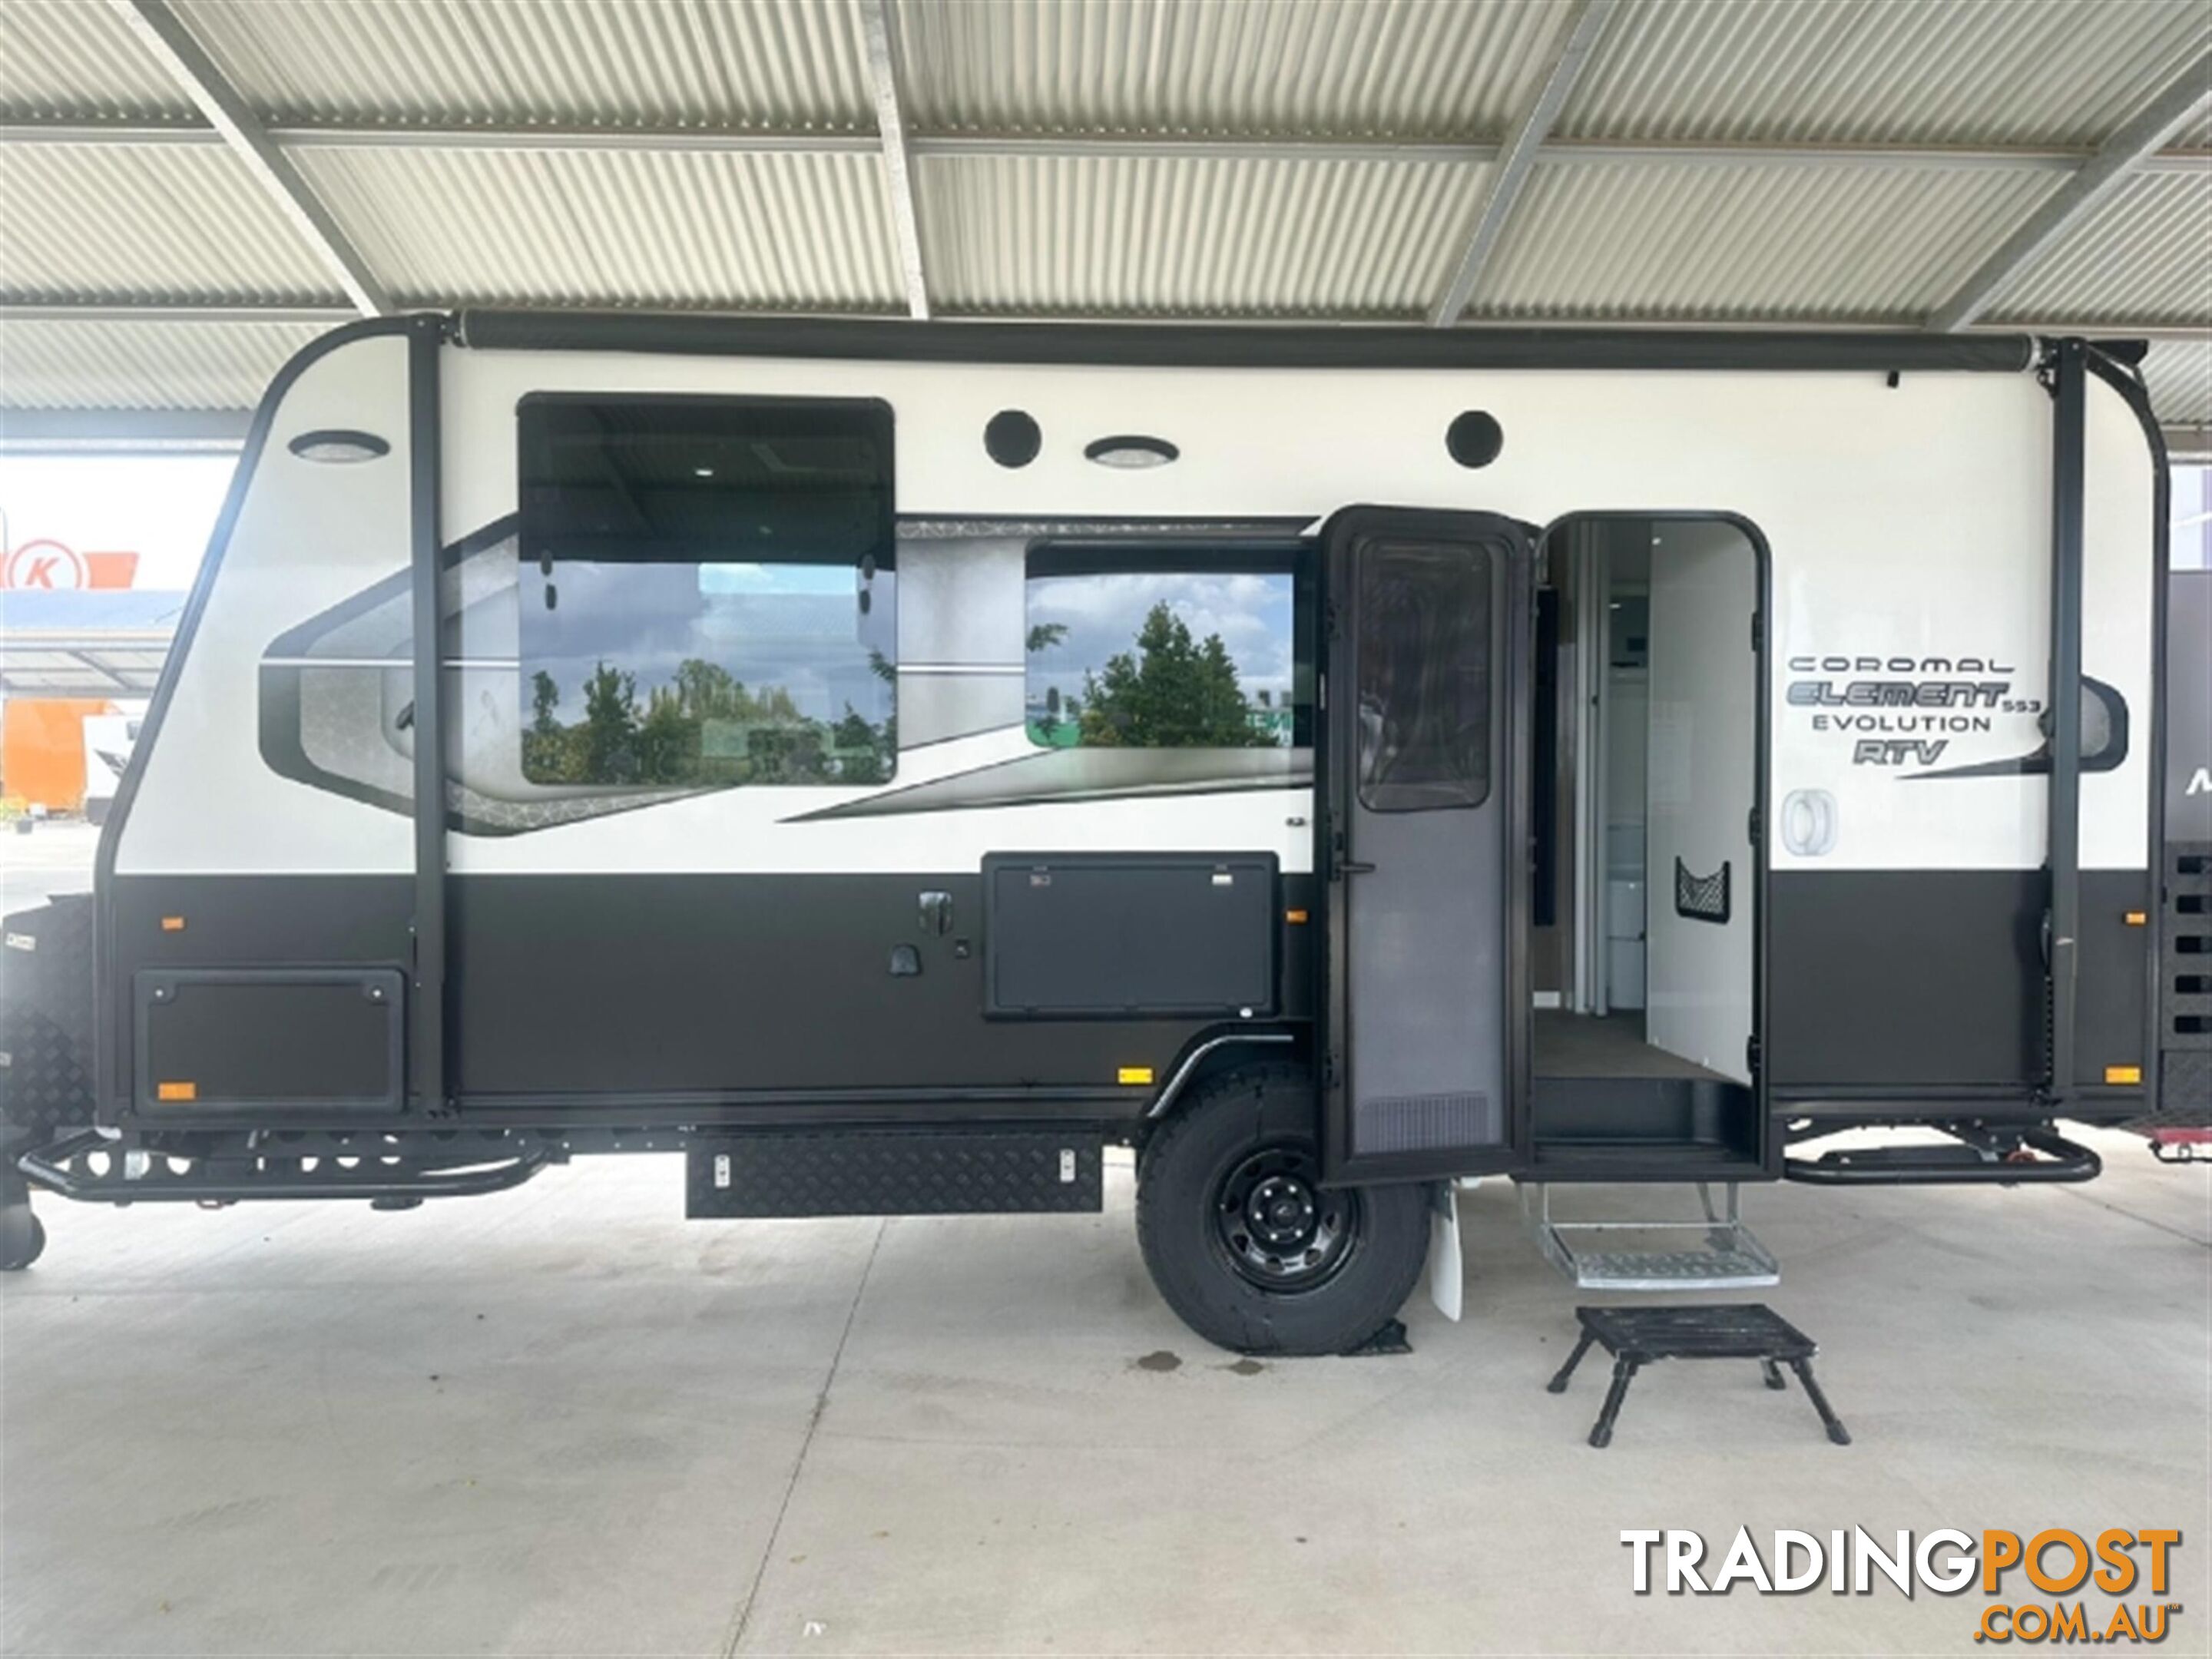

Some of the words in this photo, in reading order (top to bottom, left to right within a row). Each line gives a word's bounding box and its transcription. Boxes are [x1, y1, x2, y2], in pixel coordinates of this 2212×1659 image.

[25, 557, 60, 590] K
[1788, 657, 2015, 674] COROMAL
[1786, 680, 2010, 708] ELEMENT
[1812, 714, 1991, 731] EVOLUTION
[1852, 739, 1949, 766] RTV
